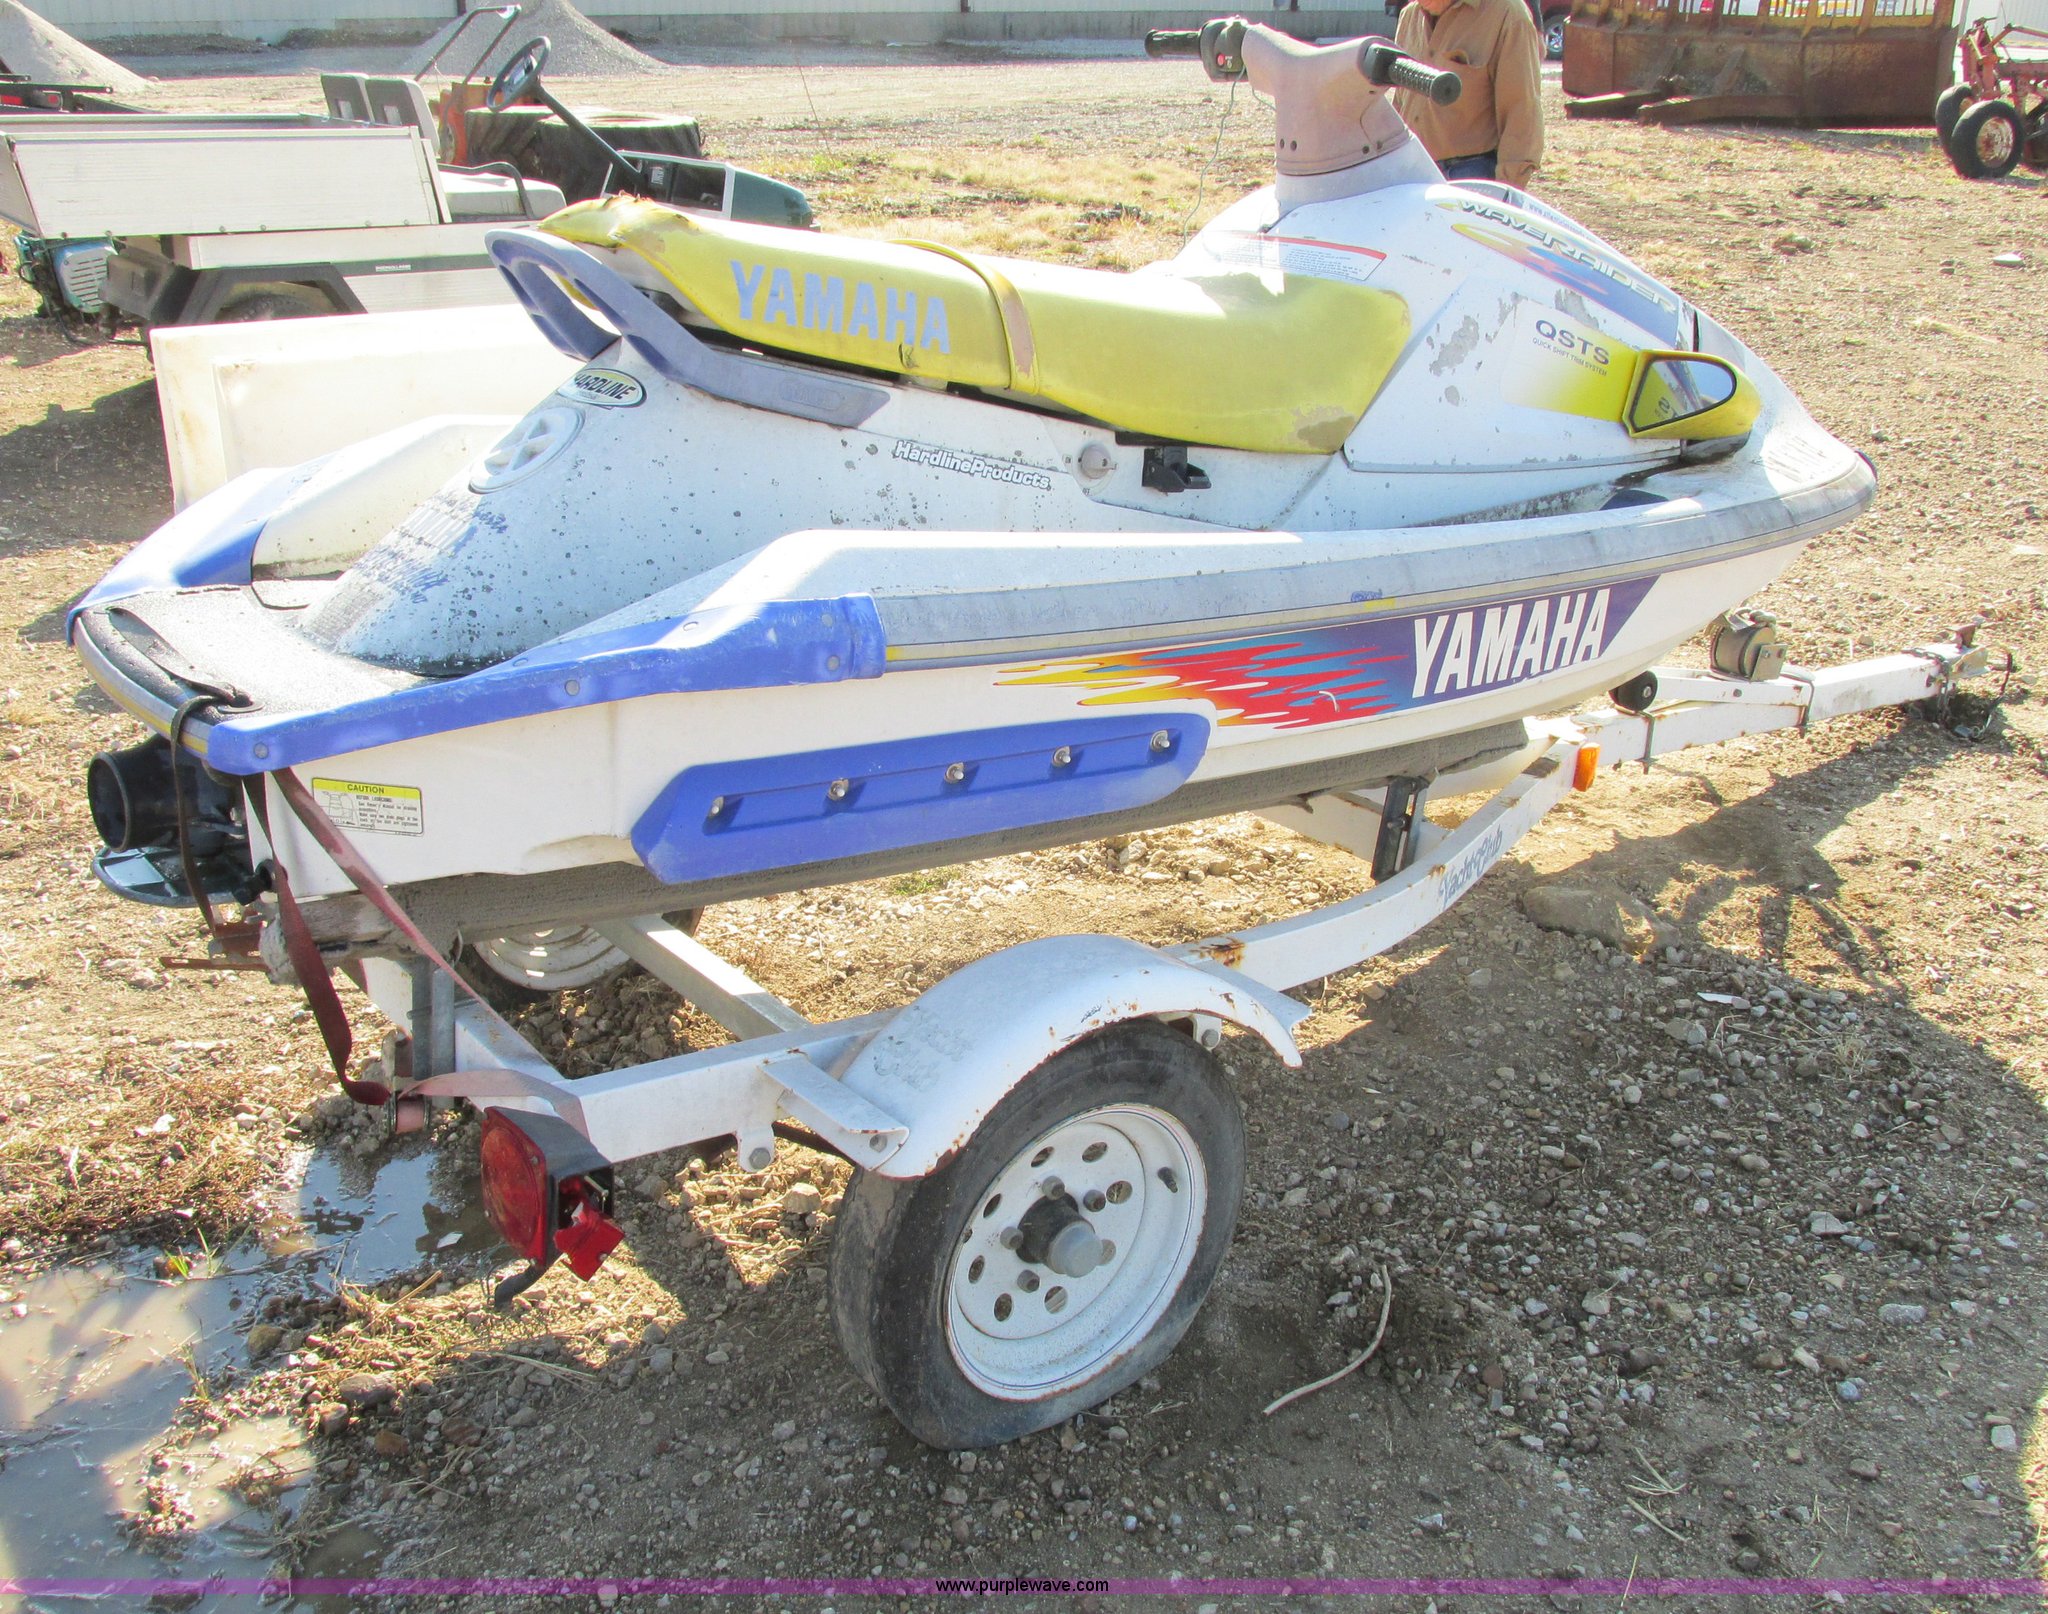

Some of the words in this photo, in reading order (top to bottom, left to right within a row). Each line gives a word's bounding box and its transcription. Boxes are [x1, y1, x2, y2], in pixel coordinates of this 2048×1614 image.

[730, 260, 951, 354] YAMAHA
[1532, 337, 1551, 350] QUICK
[1552, 346, 1570, 359] SHIFT
[1570, 354, 1584, 366] TRIM
[1584, 361, 1607, 376] SYSTEM
[1535, 319, 1609, 365] QSTS
[893, 440, 1051, 490] HardlineProducts
[1412, 588, 1611, 699] YAMAHA
[347, 783, 385, 794] CAUTION
